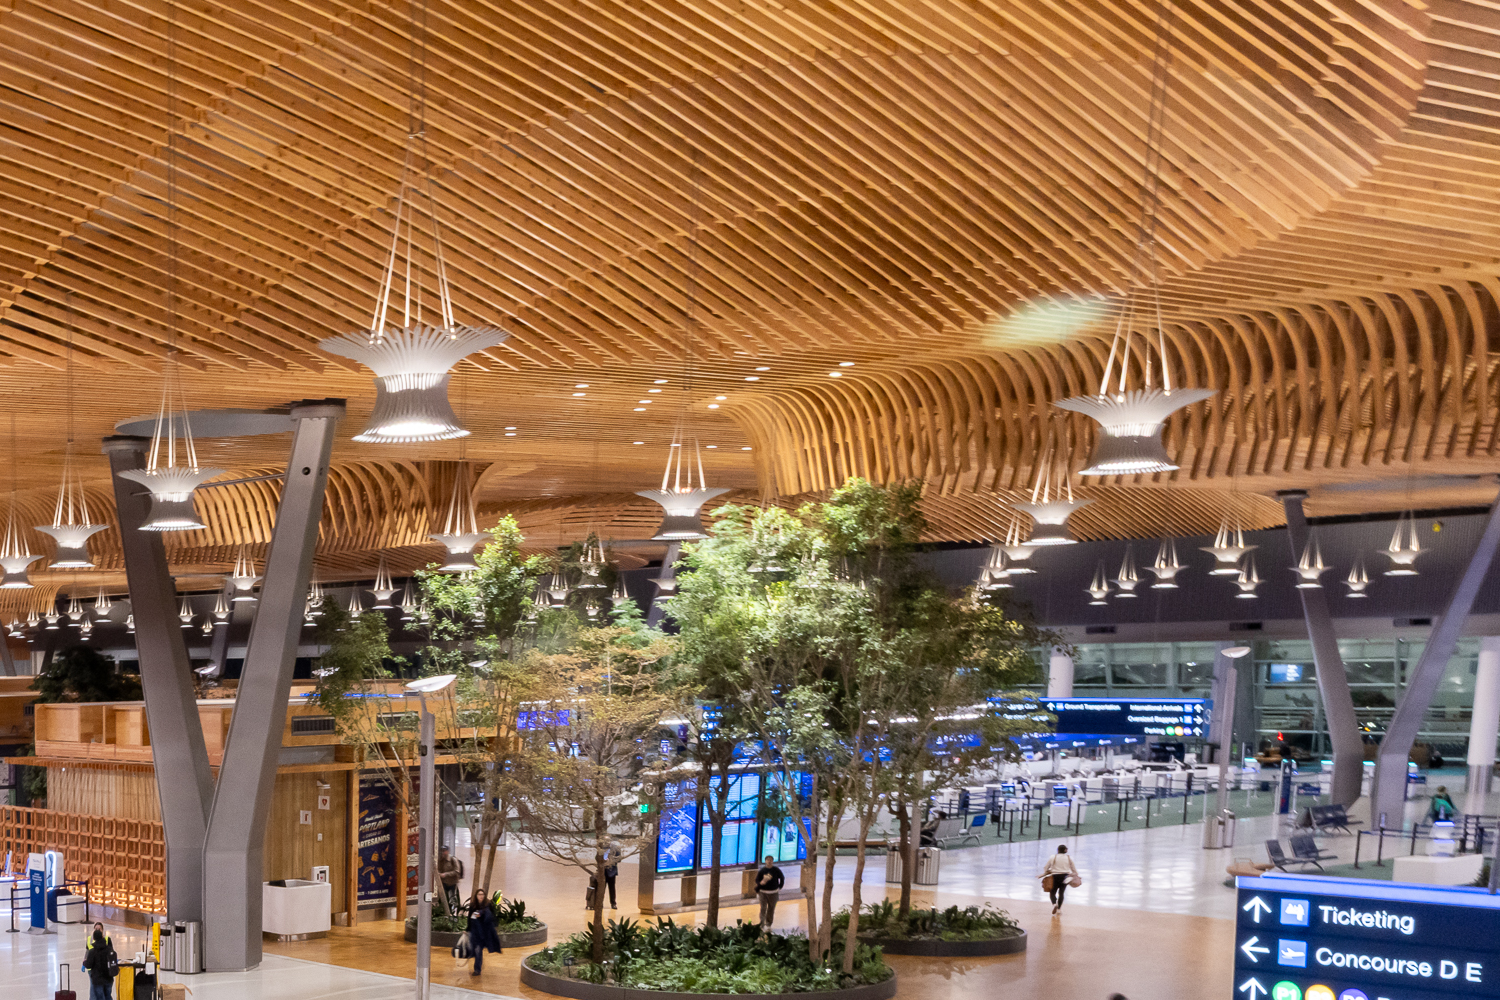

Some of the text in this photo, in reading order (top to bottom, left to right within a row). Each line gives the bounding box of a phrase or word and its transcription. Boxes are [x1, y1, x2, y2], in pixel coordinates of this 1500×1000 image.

[1064, 702, 1122, 711] Ground Transportation
[1129, 703, 1183, 712] International Arrivals
[1144, 726, 1166, 736] Parking
[357, 834, 391, 849] ARTESANOS
[1318, 904, 1416, 935] Ticketing
[1315, 946, 1484, 983] Concourse D E
